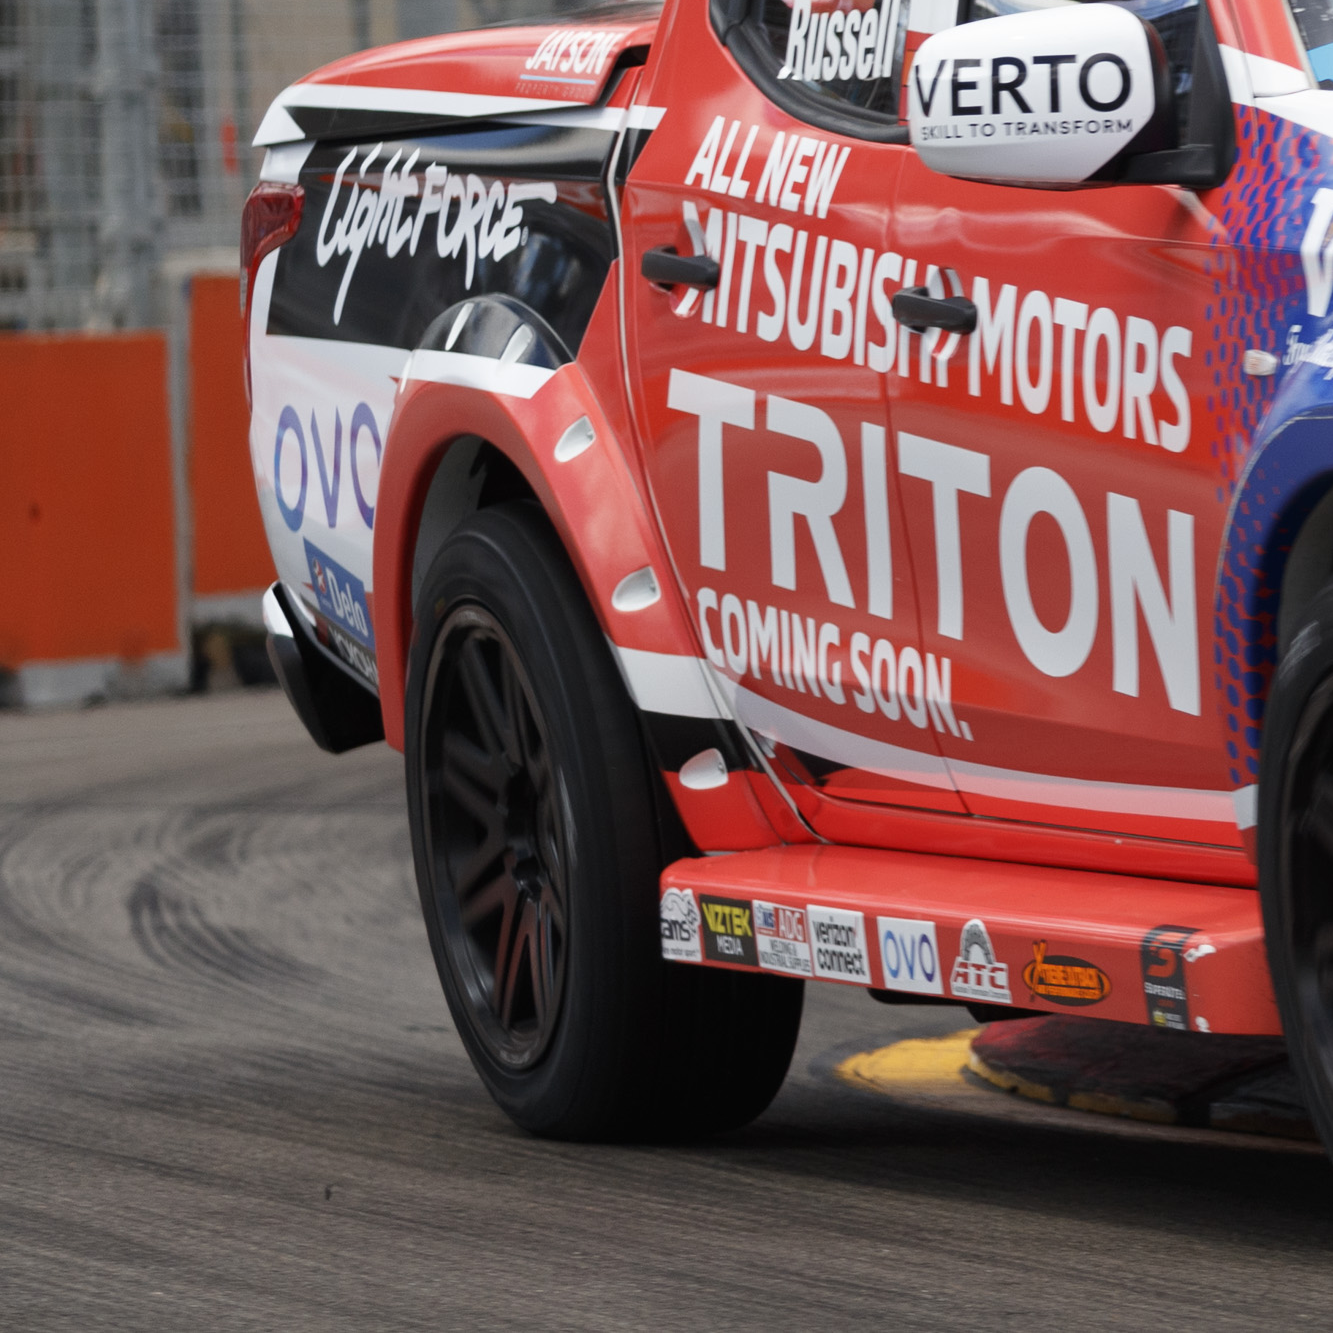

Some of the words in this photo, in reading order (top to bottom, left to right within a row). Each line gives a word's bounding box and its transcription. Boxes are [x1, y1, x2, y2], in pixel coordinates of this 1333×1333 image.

[525, 29, 622, 75] JAYSON
[914, 52, 1132, 118] VERTO
[920, 123, 964, 142] SKILL
[970, 121, 996, 138] TO
[1003, 117, 1134, 139] TRANSFORM
[684, 115, 759, 200] ALL
[756, 130, 851, 221] NEW
[674, 200, 965, 388] MITSUBISHI
[969, 276, 1193, 454] MOTORS
[666, 366, 1202, 717] TRITON
[325, 565, 370, 639] Delo
[697, 586, 843, 707] COMING
[849, 631, 975, 743] SOON.
[701, 901, 754, 938] VIZTEK
[777, 907, 805, 943] ADG
[812, 915, 857, 948] verizon
[716, 934, 745, 957] MEDIA
[816, 946, 867, 977] connect
[882, 929, 937, 983] OVO
